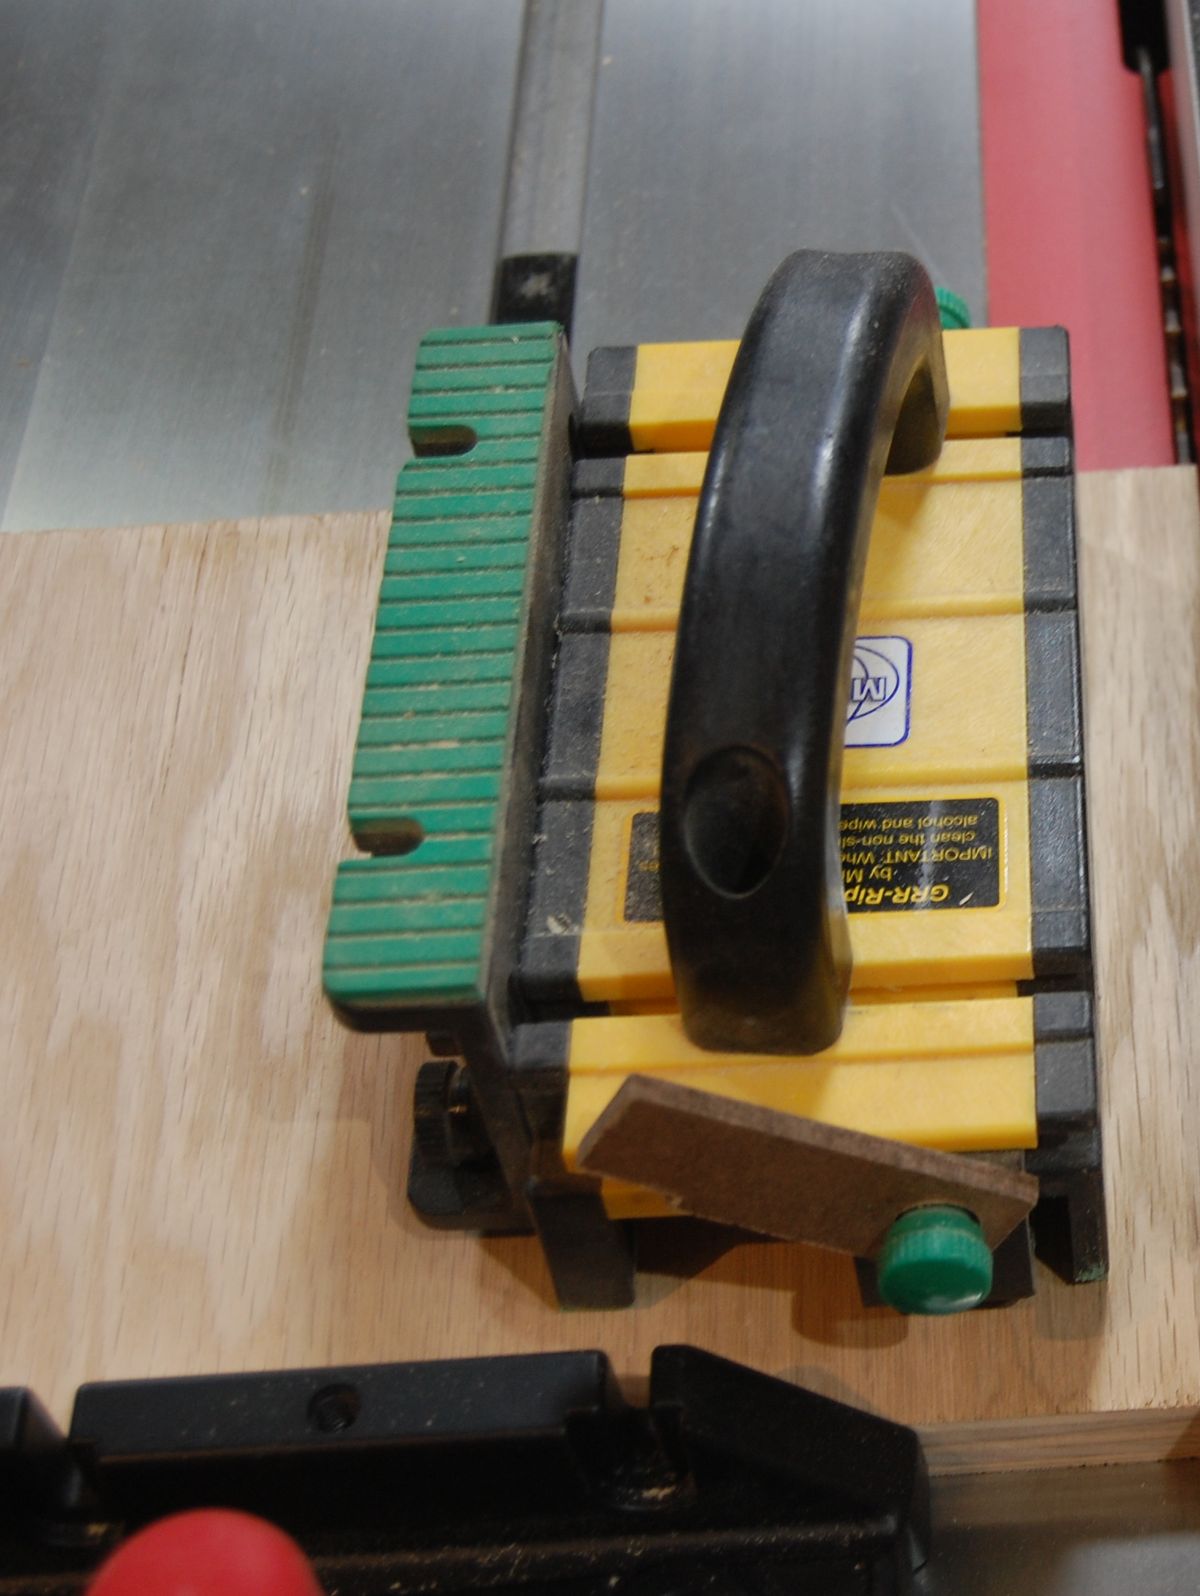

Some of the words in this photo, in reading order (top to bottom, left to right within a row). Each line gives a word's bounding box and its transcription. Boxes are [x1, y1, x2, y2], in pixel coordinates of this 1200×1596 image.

[881, 817, 915, 831] and
[917, 814, 979, 830] alcohol
[899, 832, 926, 845] the
[929, 830, 978, 844] clean
[869, 865, 893, 882] by
